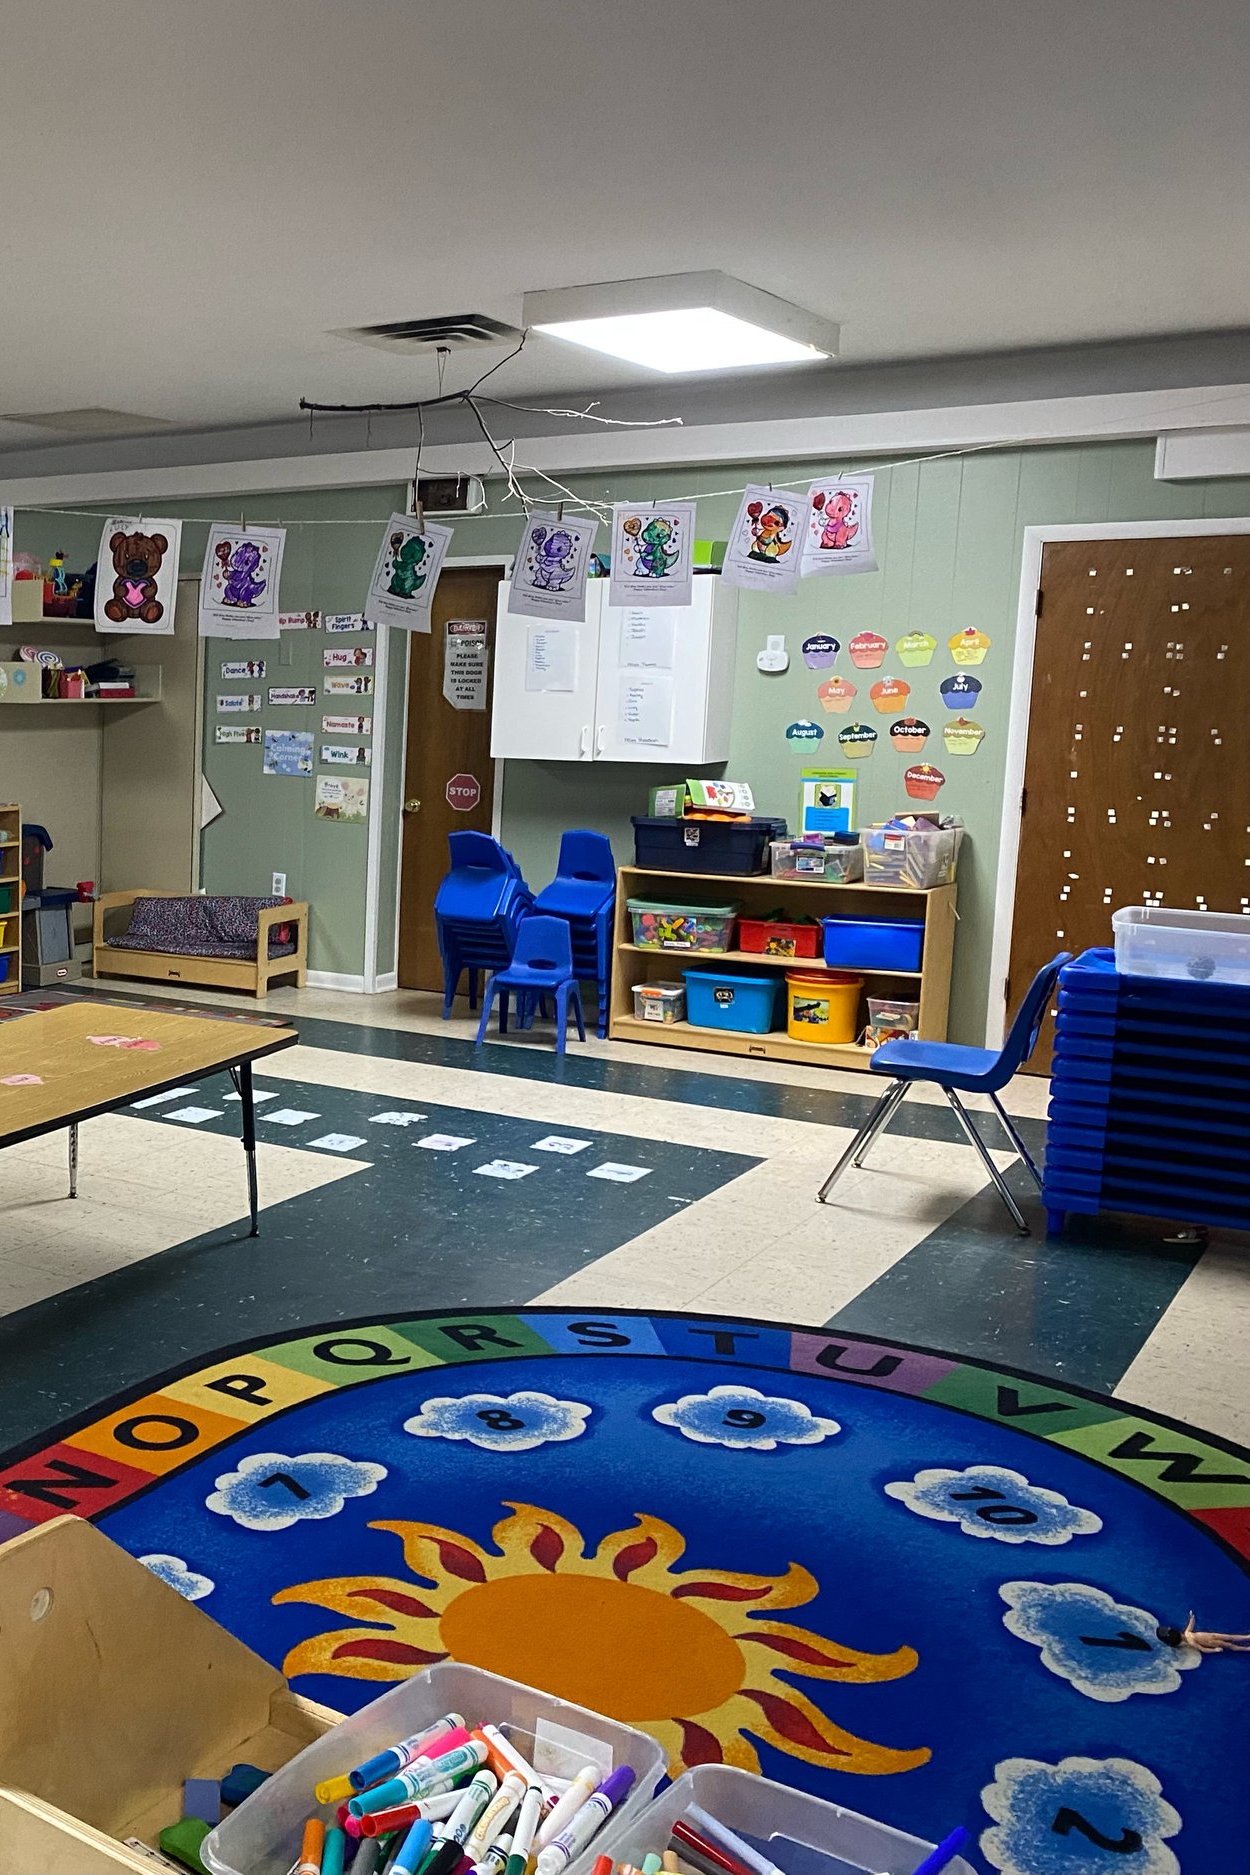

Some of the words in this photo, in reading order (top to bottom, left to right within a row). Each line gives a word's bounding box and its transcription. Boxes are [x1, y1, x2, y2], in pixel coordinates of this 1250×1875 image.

[335, 616, 352, 624] Spirit
[332, 623, 355, 631] Fingers
[806, 642, 836, 651] January
[850, 641, 886, 650] February
[960, 638, 980, 646] April
[333, 654, 347, 662] Hug
[226, 667, 246, 675] Dance
[828, 687, 845, 695] May
[953, 683, 969, 692] July
[792, 728, 817, 737] August
[894, 726, 926, 734] October
[944, 727, 983, 736] November
[839, 731, 877, 741] September
[271, 743, 307, 754] Calming
[273, 752, 303, 761] Corner
[331, 749, 349, 759] Wink
[907, 771, 944, 783] December
[449, 786, 477, 798] STOP
[6, 1459, 121, 1510] N
[113, 1414, 199, 1451] O
[205, 1373, 274, 1406] P
[313, 1338, 412, 1367] Q
[438, 1324, 524, 1352] R
[567, 1322, 632, 1347] S
[688, 1328, 760, 1355] T
[813, 1345, 903, 1379] U
[996, 1385, 1075, 1418] V
[1109, 1431, 1250, 1486] W
[476, 1408, 526, 1431] 8
[721, 1408, 768, 1429] 9
[258, 1473, 310, 1501] 7
[951, 1485, 1039, 1526] 10
[1079, 1630, 1152, 1653] 1
[1051, 1806, 1145, 1854] 2
